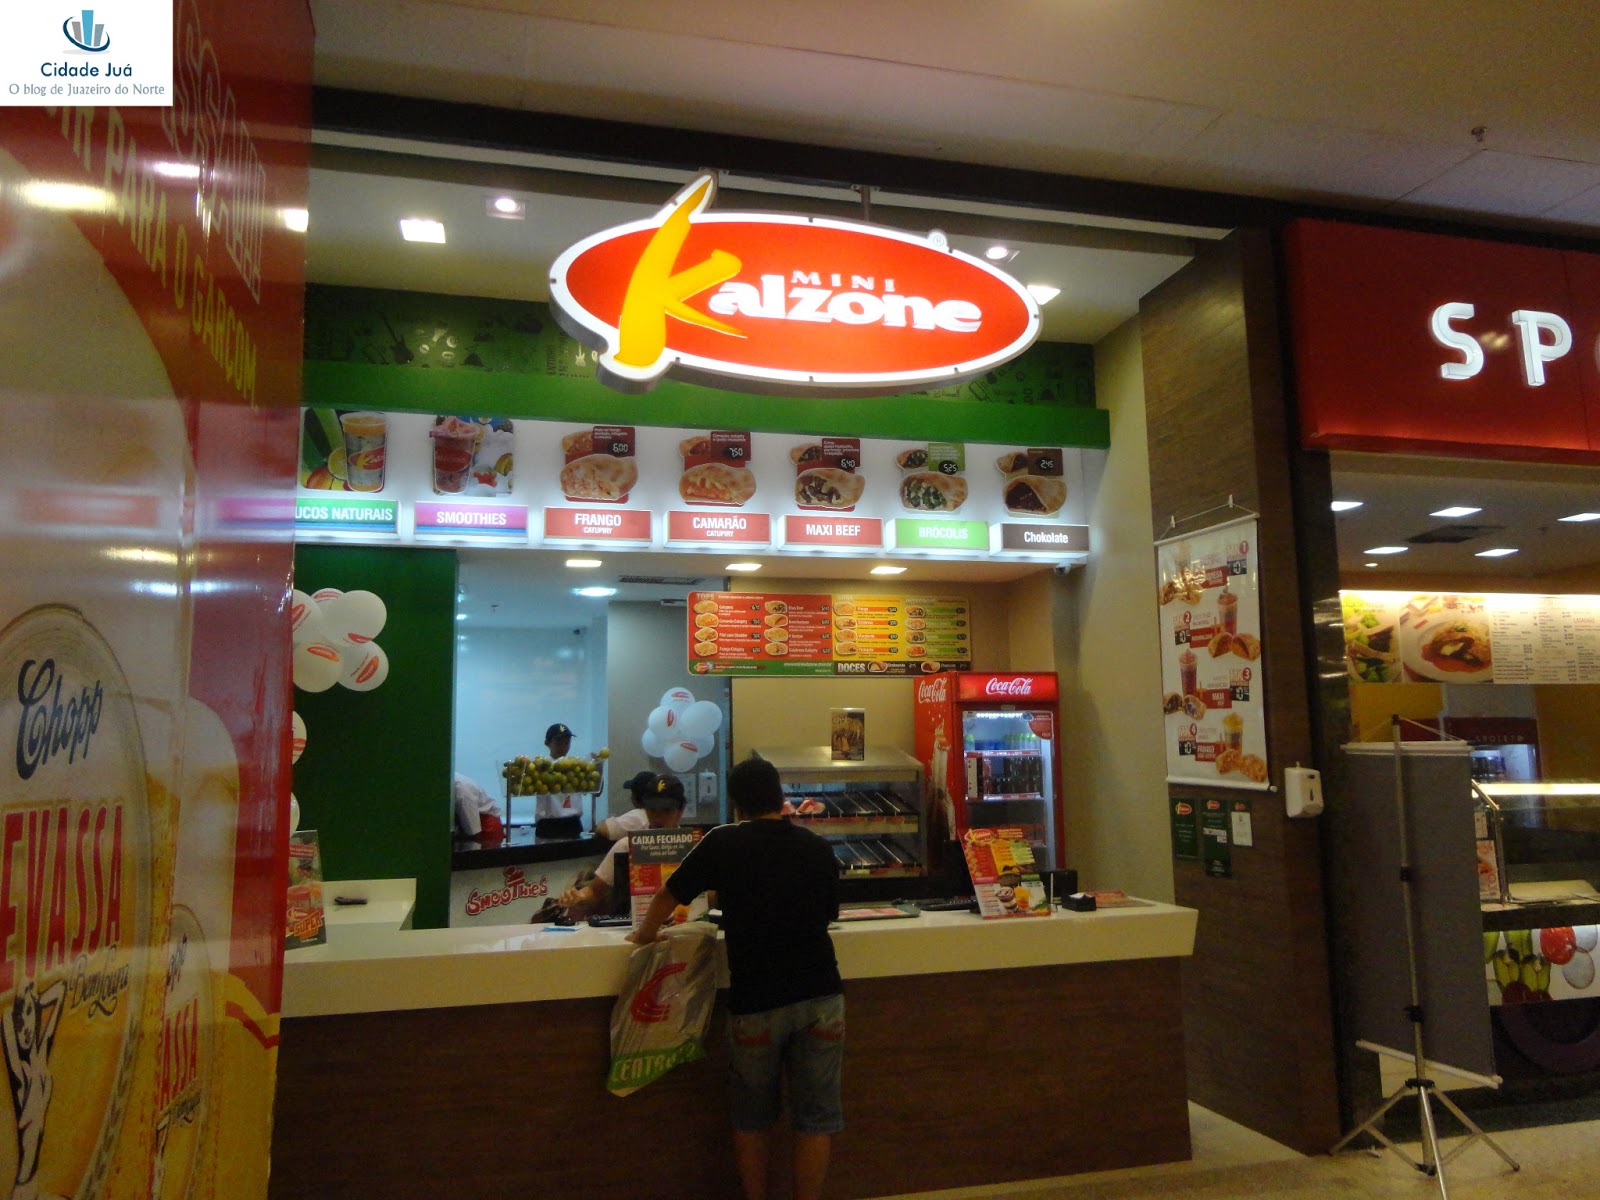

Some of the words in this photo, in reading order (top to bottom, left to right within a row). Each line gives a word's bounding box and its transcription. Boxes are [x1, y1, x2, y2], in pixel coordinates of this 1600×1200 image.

[104, 108, 168, 289] PARA
[174, 223, 188, 310] O
[613, 175, 983, 368] Kalzone
[790, 270, 896, 293] MINI
[1431, 301, 1600, 387] SP
[332, 506, 393, 522] NATURAIS
[436, 510, 507, 526] SMOOTHIES
[574, 512, 622, 528] FRANGO
[692, 514, 747, 531] CAMARÃO
[805, 523, 833, 536] MAXI
[835, 524, 861, 537] BEEF
[584, 527, 614, 535] CATUPIRY
[706, 530, 734, 538] CATUPIRY
[1023, 530, 1069, 544] Chokolate
[838, 662, 866, 673] DOCES
[918, 676, 948, 704] Coca-Cola
[985, 676, 1034, 696] Coca-Cola
[16, 657, 104, 780] Chopp
[631, 835, 656, 845] CAIXA
[657, 833, 693, 844] FECHADO
